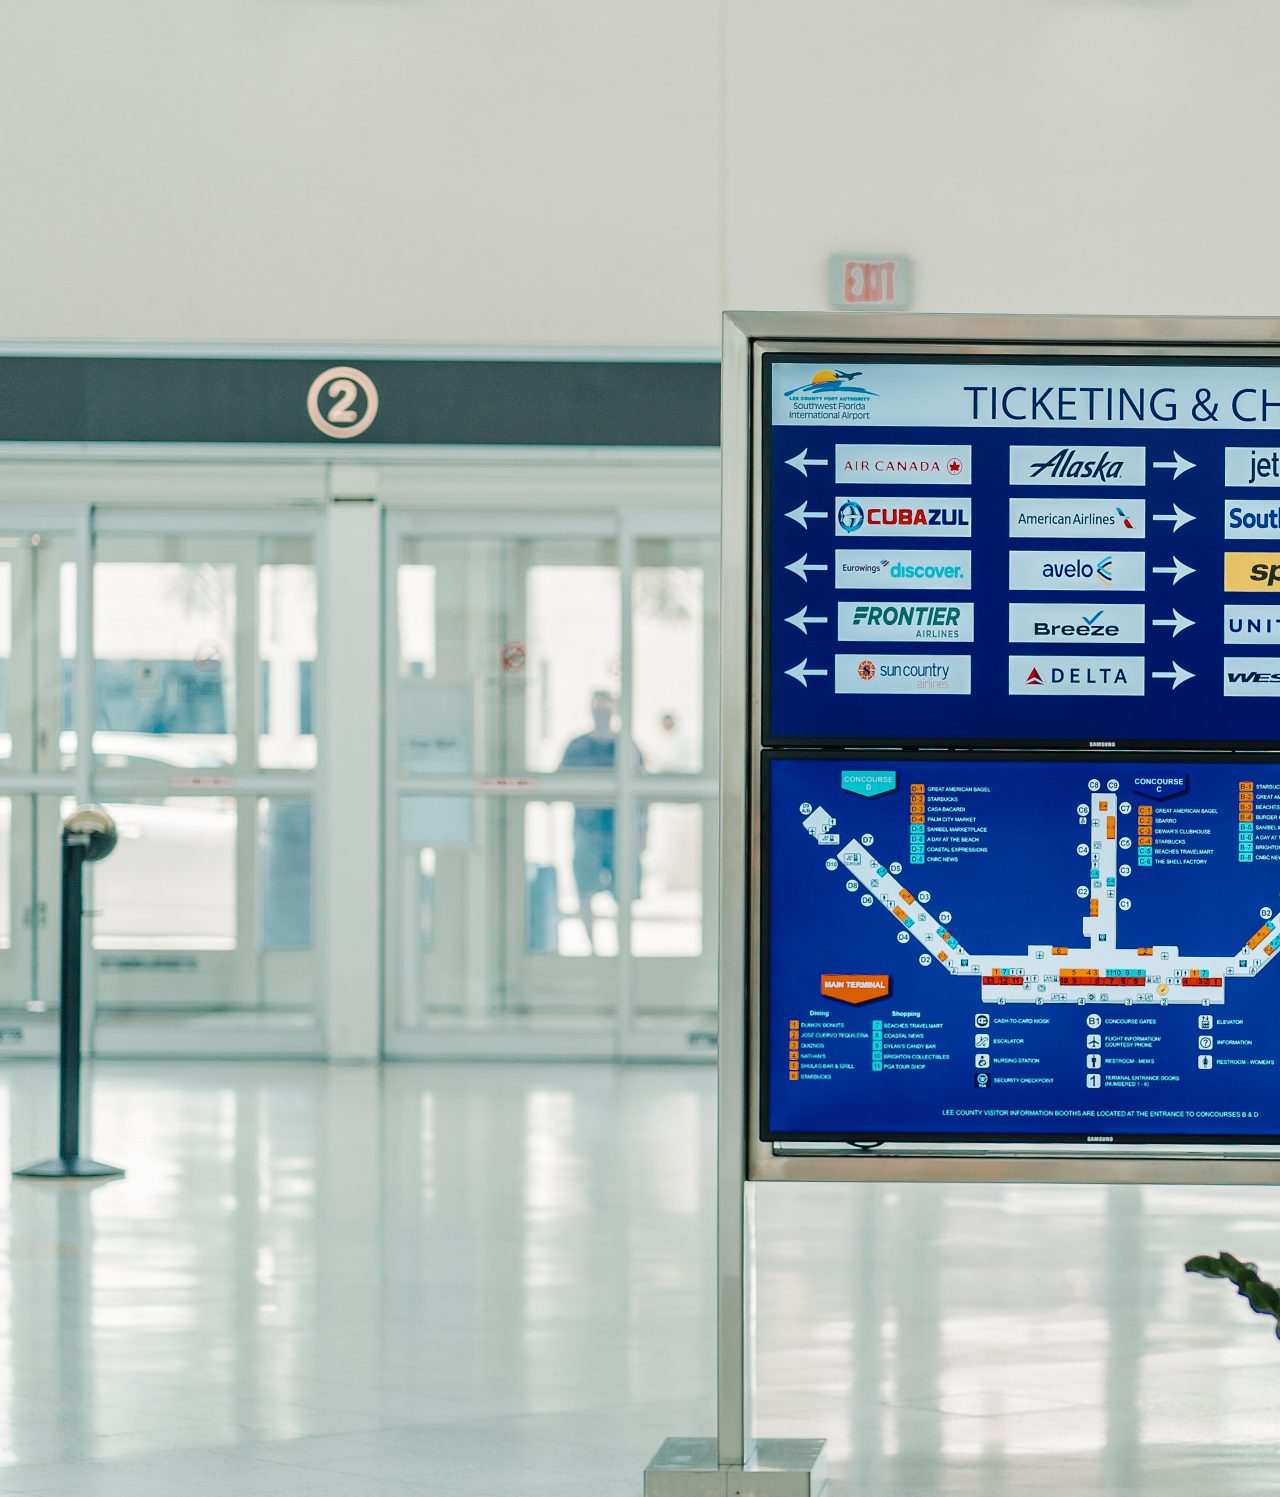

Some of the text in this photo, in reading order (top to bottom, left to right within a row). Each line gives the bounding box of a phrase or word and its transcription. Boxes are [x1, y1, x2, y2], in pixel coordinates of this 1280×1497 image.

[327, 379, 358, 423] 2
[963, 386, 1177, 421] TICKETING
[1191, 387, 1219, 422] &
[842, 412, 870, 420] Airport
[844, 461, 940, 471] AIR CANADA
[1029, 449, 1124, 482] Alaska
[867, 509, 968, 525] CUBAZUL
[1018, 513, 1115, 525] American Airlines
[843, 564, 880, 573] Eurowings
[1043, 559, 1093, 577] avelo
[853, 607, 960, 625] FRONTIER
[916, 630, 959, 638] AIRLINES
[1034, 622, 1119, 636] Breeze
[880, 663, 949, 680] sun country
[1051, 668, 1127, 684] DELTA
[917, 679, 950, 689] airlines
